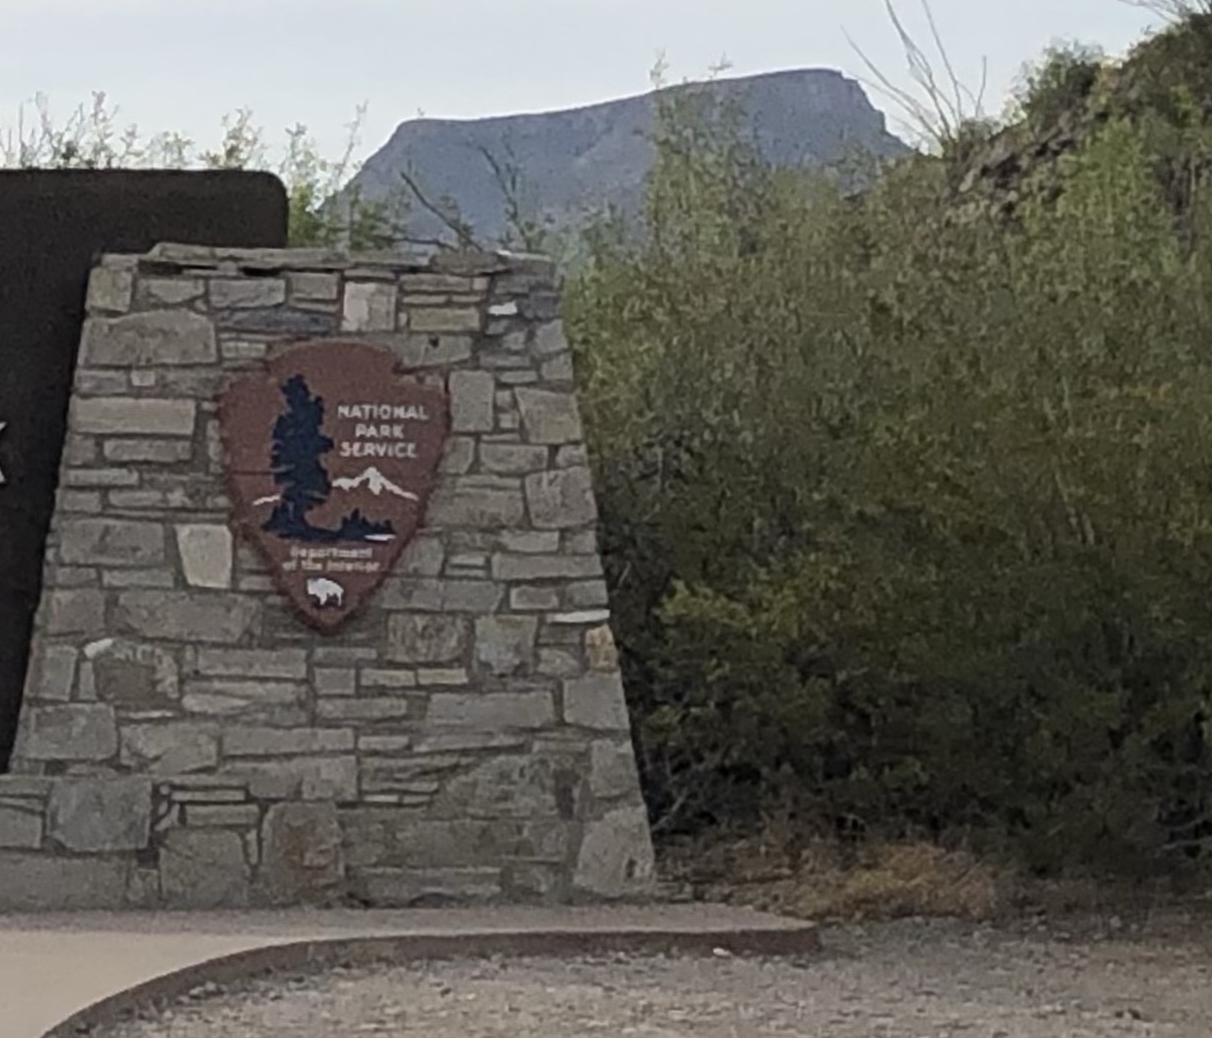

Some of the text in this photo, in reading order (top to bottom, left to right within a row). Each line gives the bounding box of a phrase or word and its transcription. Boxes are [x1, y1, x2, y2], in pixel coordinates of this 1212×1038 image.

[338, 404, 429, 420] NATIONAL
[355, 423, 405, 439] PARK
[340, 441, 418, 458] SERVICE
